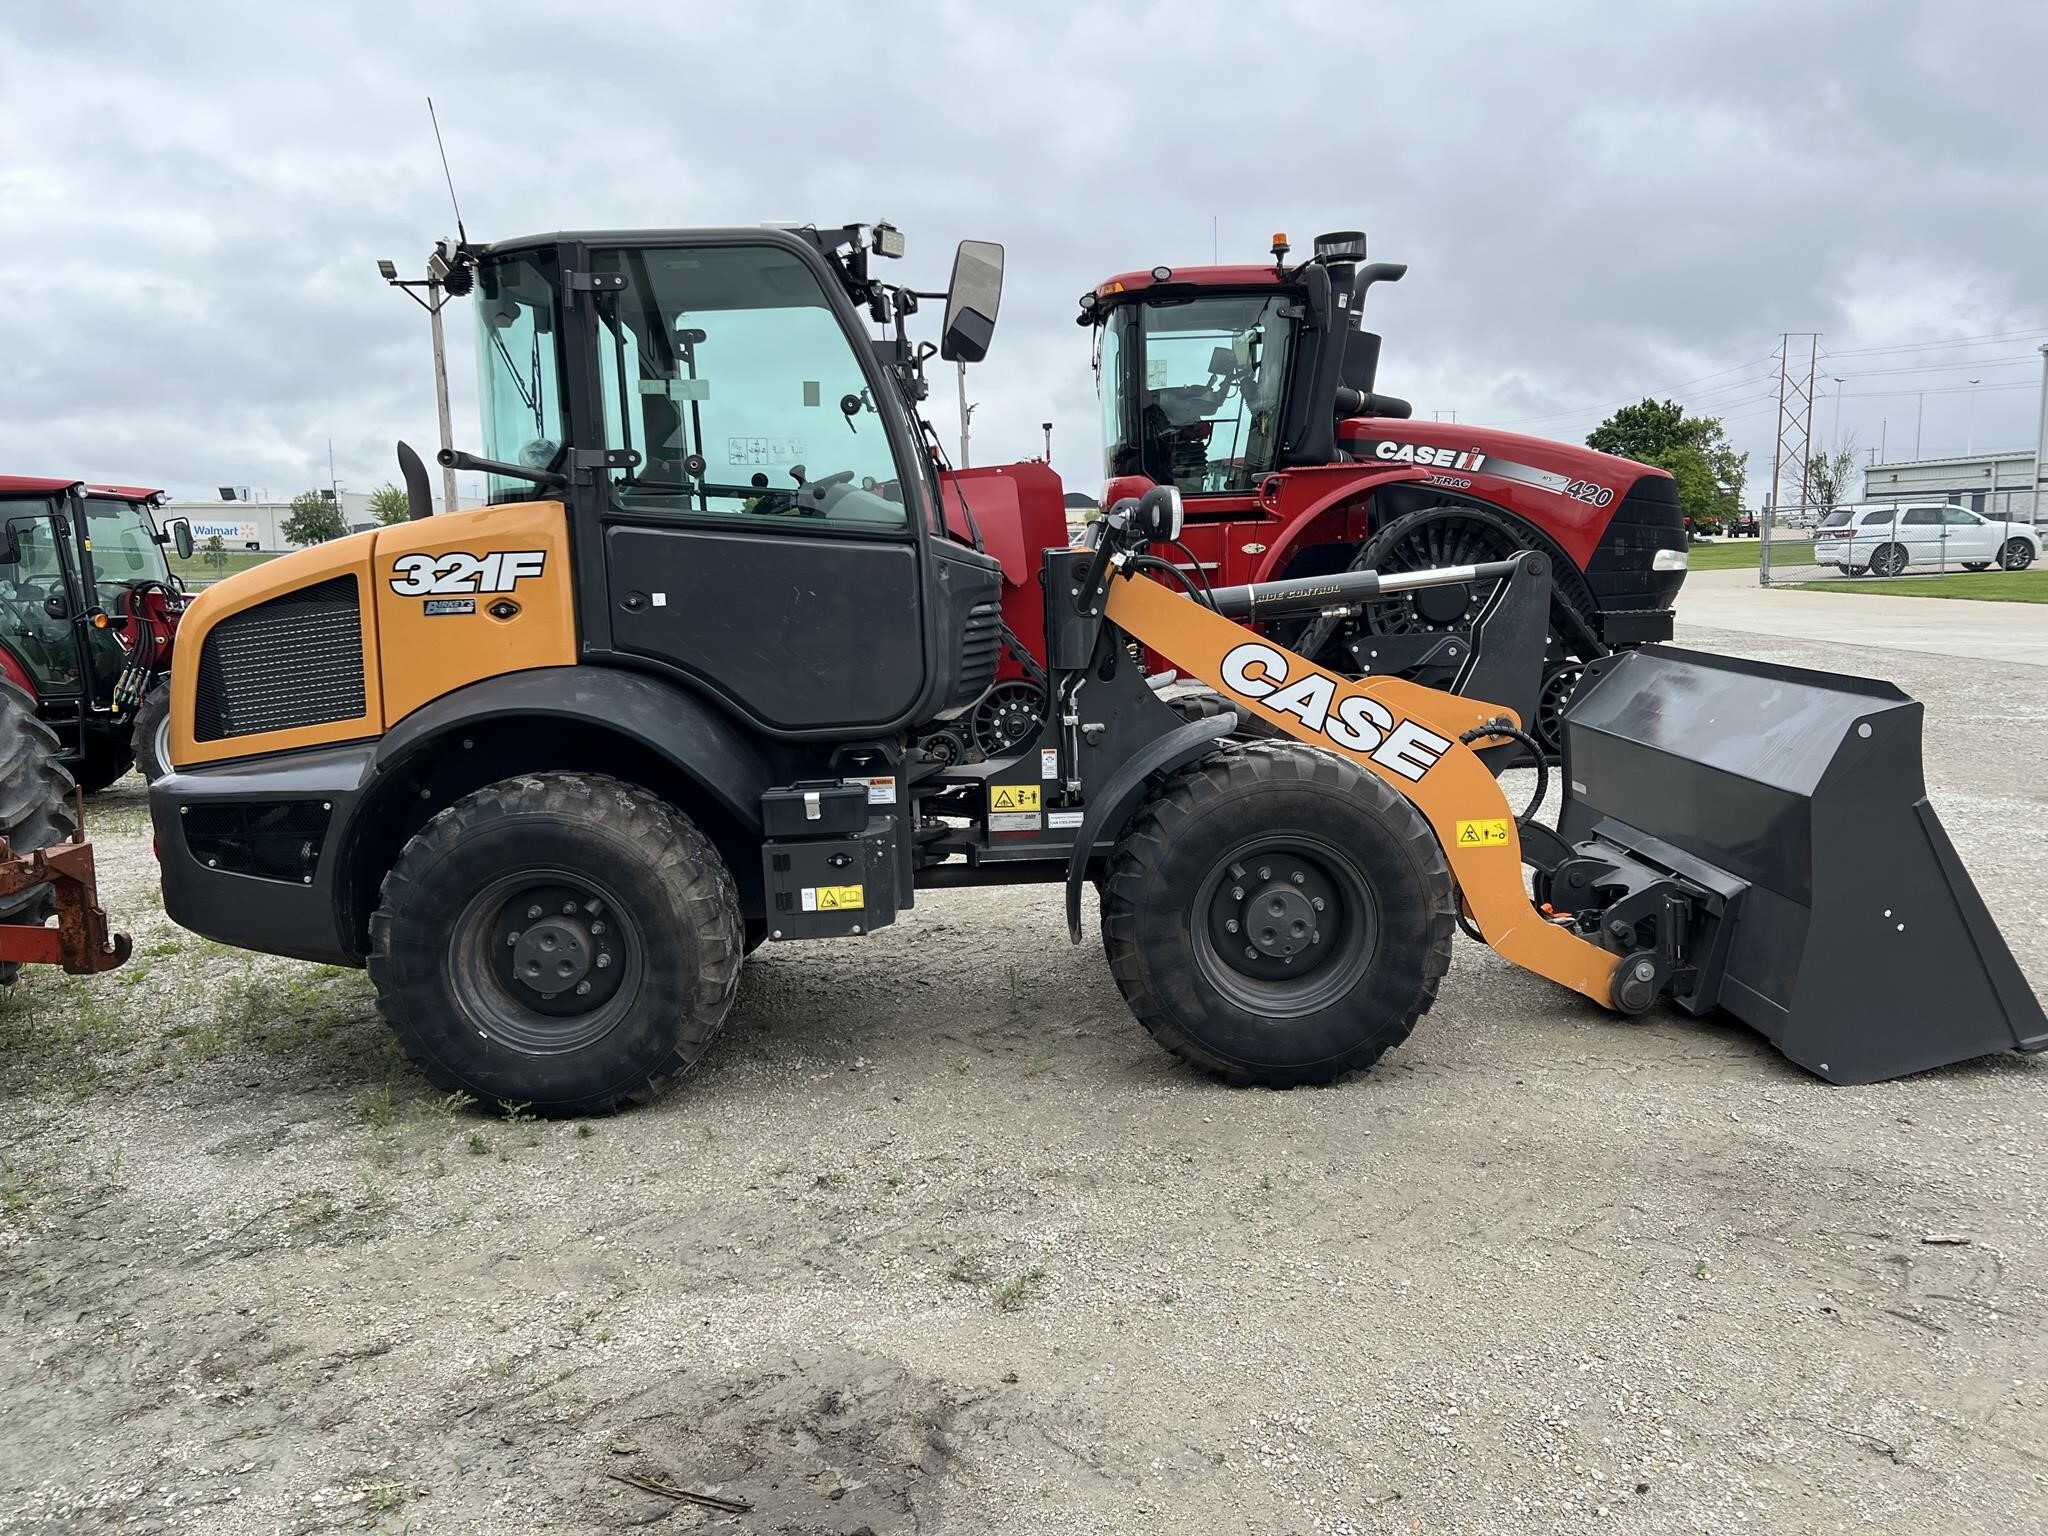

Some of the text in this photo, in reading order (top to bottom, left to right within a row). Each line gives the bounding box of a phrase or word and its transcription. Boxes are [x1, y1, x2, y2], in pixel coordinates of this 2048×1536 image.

[1376, 441, 1456, 467] CASE
[1565, 480, 1613, 508] 420
[194, 525, 239, 536] Walmart
[389, 550, 547, 597] 321F
[1287, 584, 1342, 599] CONTROL
[1220, 642, 1455, 783] CASE
